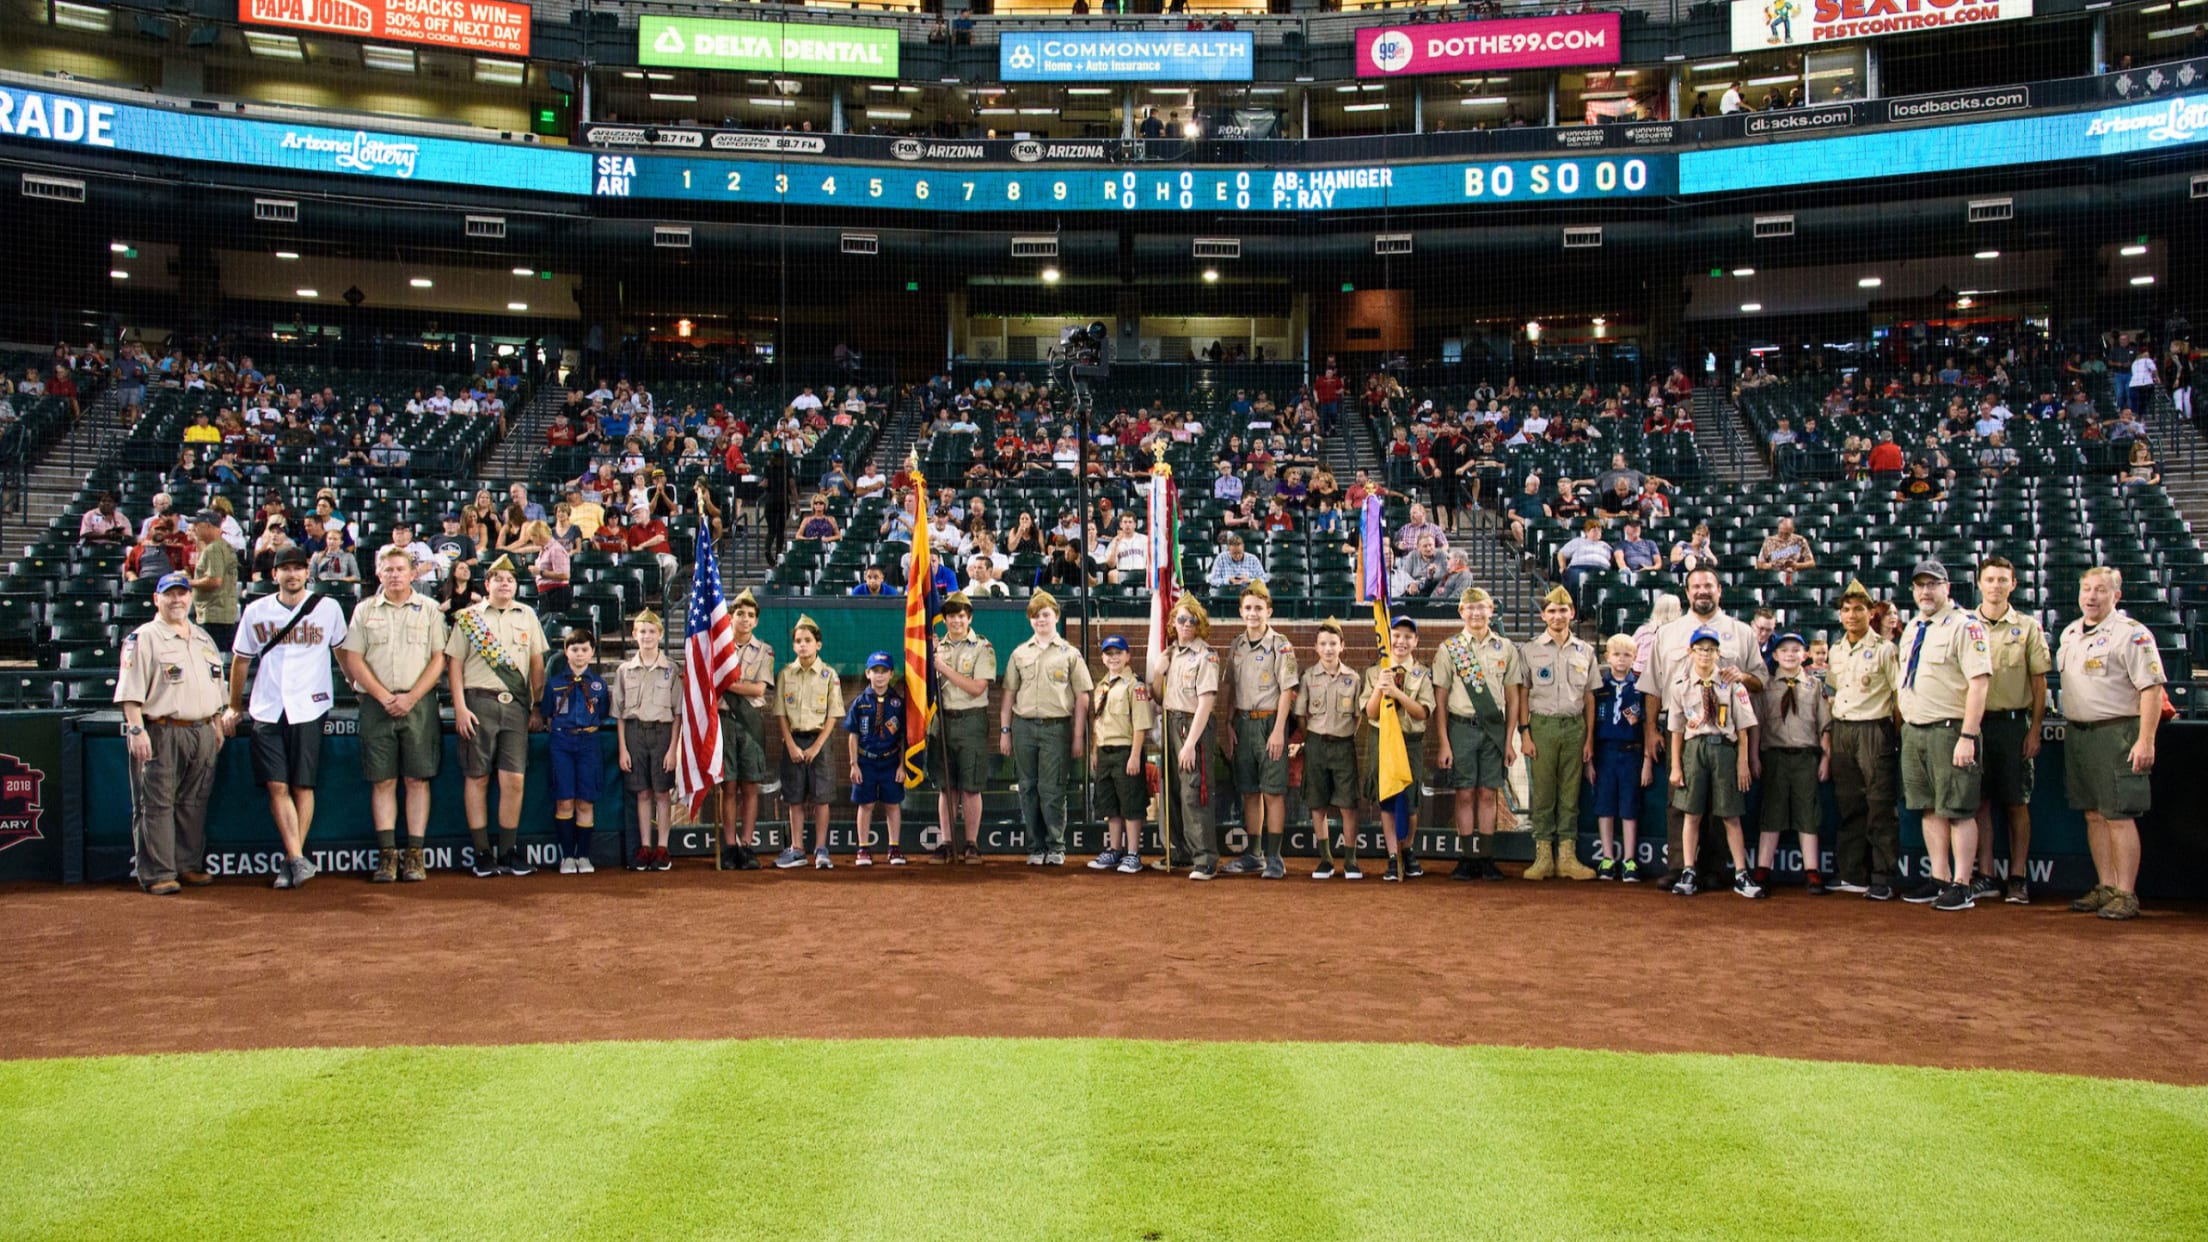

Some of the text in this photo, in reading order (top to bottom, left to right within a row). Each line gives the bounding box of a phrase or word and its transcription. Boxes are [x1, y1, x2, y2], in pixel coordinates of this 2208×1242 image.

[255, 0, 369, 28] PAPA JOHNS
[385, 0, 465, 18] D-BACKS
[385, 11, 521, 41] 50% OFF NEXT DAY
[1812, 5, 2000, 41] PESTCONTROL.COM
[384, 27, 424, 38] PROMO
[426, 32, 460, 43] CODE:
[462, 37, 506, 48] DBACKS
[1427, 29, 1605, 58] DOTHE99.COM
[694, 34, 884, 64] DELTA DENTAL
[1043, 41, 1245, 57] COMMONWEALTH
[1044, 60, 1073, 72] Home
[1086, 60, 1109, 72] Auto
[1111, 60, 1161, 72] Insurance
[1893, 92, 2024, 117] losdbacks.com
[592, 129, 648, 137] ARIZON
[2085, 112, 2168, 137] Arizona
[653, 133, 695, 144] 8.7 FM
[776, 138, 817, 149] 98.7 FM
[281, 130, 419, 178] Arizona Lottery
[897, 143, 984, 159] FOX ARIZONA
[1018, 145, 1105, 159] FOX ARIZONA
[598, 157, 637, 177] SEA
[596, 177, 630, 196] ARI
[682, 169, 1117, 201] 1 2 3 4 5 6 7 8 9 R
[1273, 168, 1393, 190] AB: HANIGER
[1156, 182, 1169, 200] H
[1216, 182, 1228, 200] E
[1273, 188, 1335, 209] P: RAY
[323, 720, 360, 735] @DB
[6, 780, 31, 792] 2018
[0, 820, 29, 830] ARY
[683, 829, 780, 849] CHSE
[988, 831, 1084, 848] CHE
[206, 852, 288, 876] SEASO
[311, 850, 405, 874] TICKE
[423, 846, 452, 869] ON
[526, 843, 578, 865] NO
[1591, 839, 1653, 864] 209
[1993, 858, 2054, 883] NW
